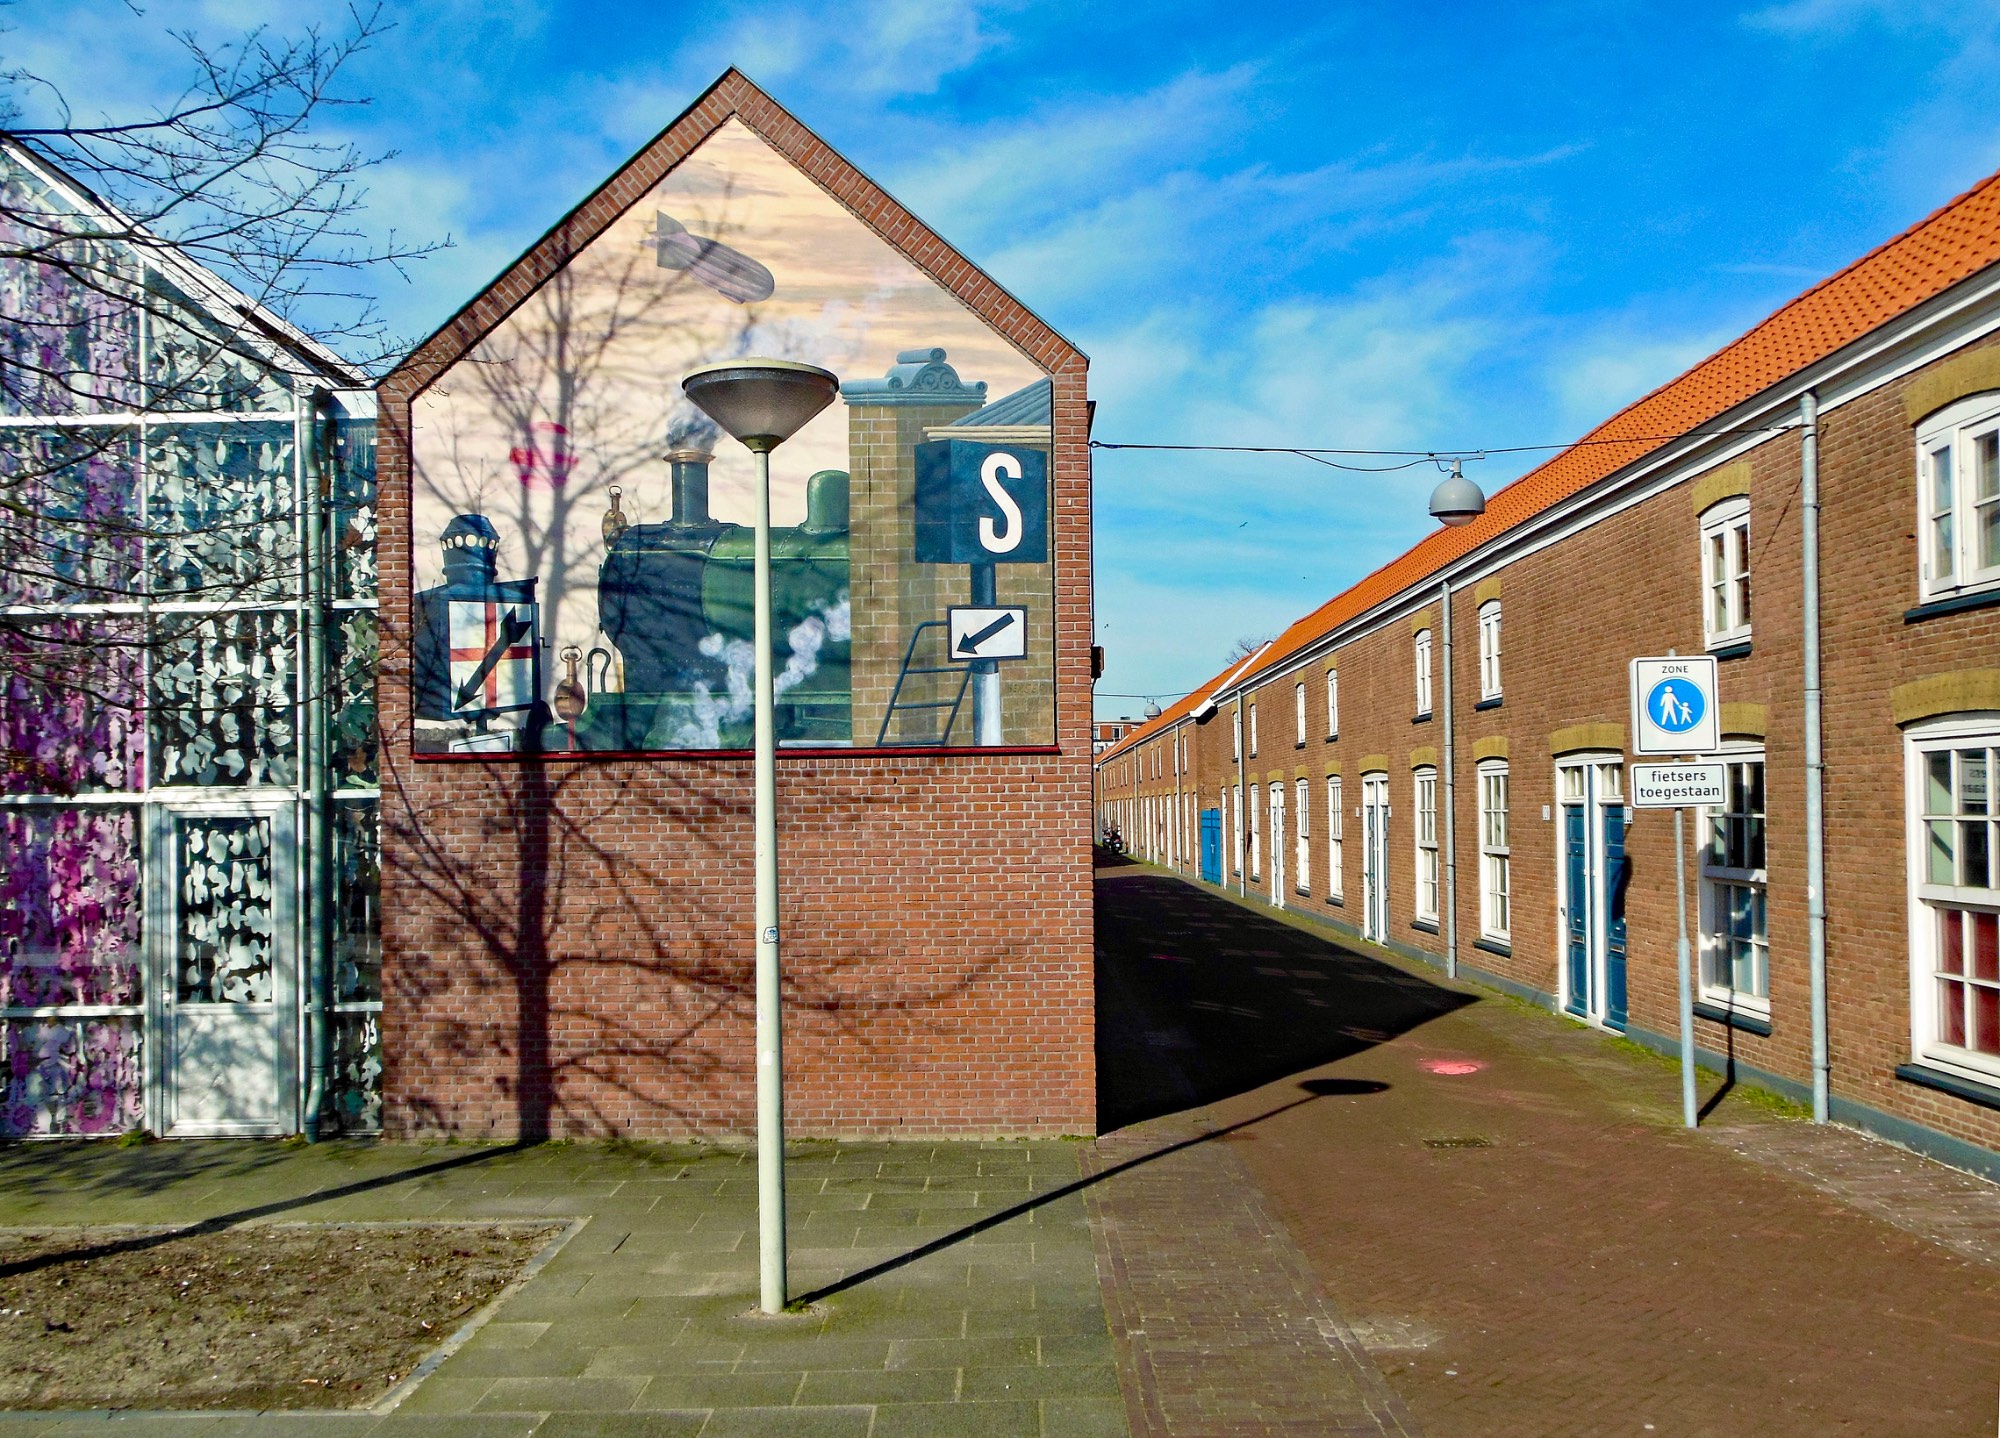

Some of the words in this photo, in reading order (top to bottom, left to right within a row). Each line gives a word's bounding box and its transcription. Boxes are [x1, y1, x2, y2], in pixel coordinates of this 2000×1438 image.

[979, 452, 1022, 553] S
[1661, 665, 1689, 674] ZONE
[1651, 770, 1707, 783] fietsers
[1640, 786, 1720, 800] toegestaan
